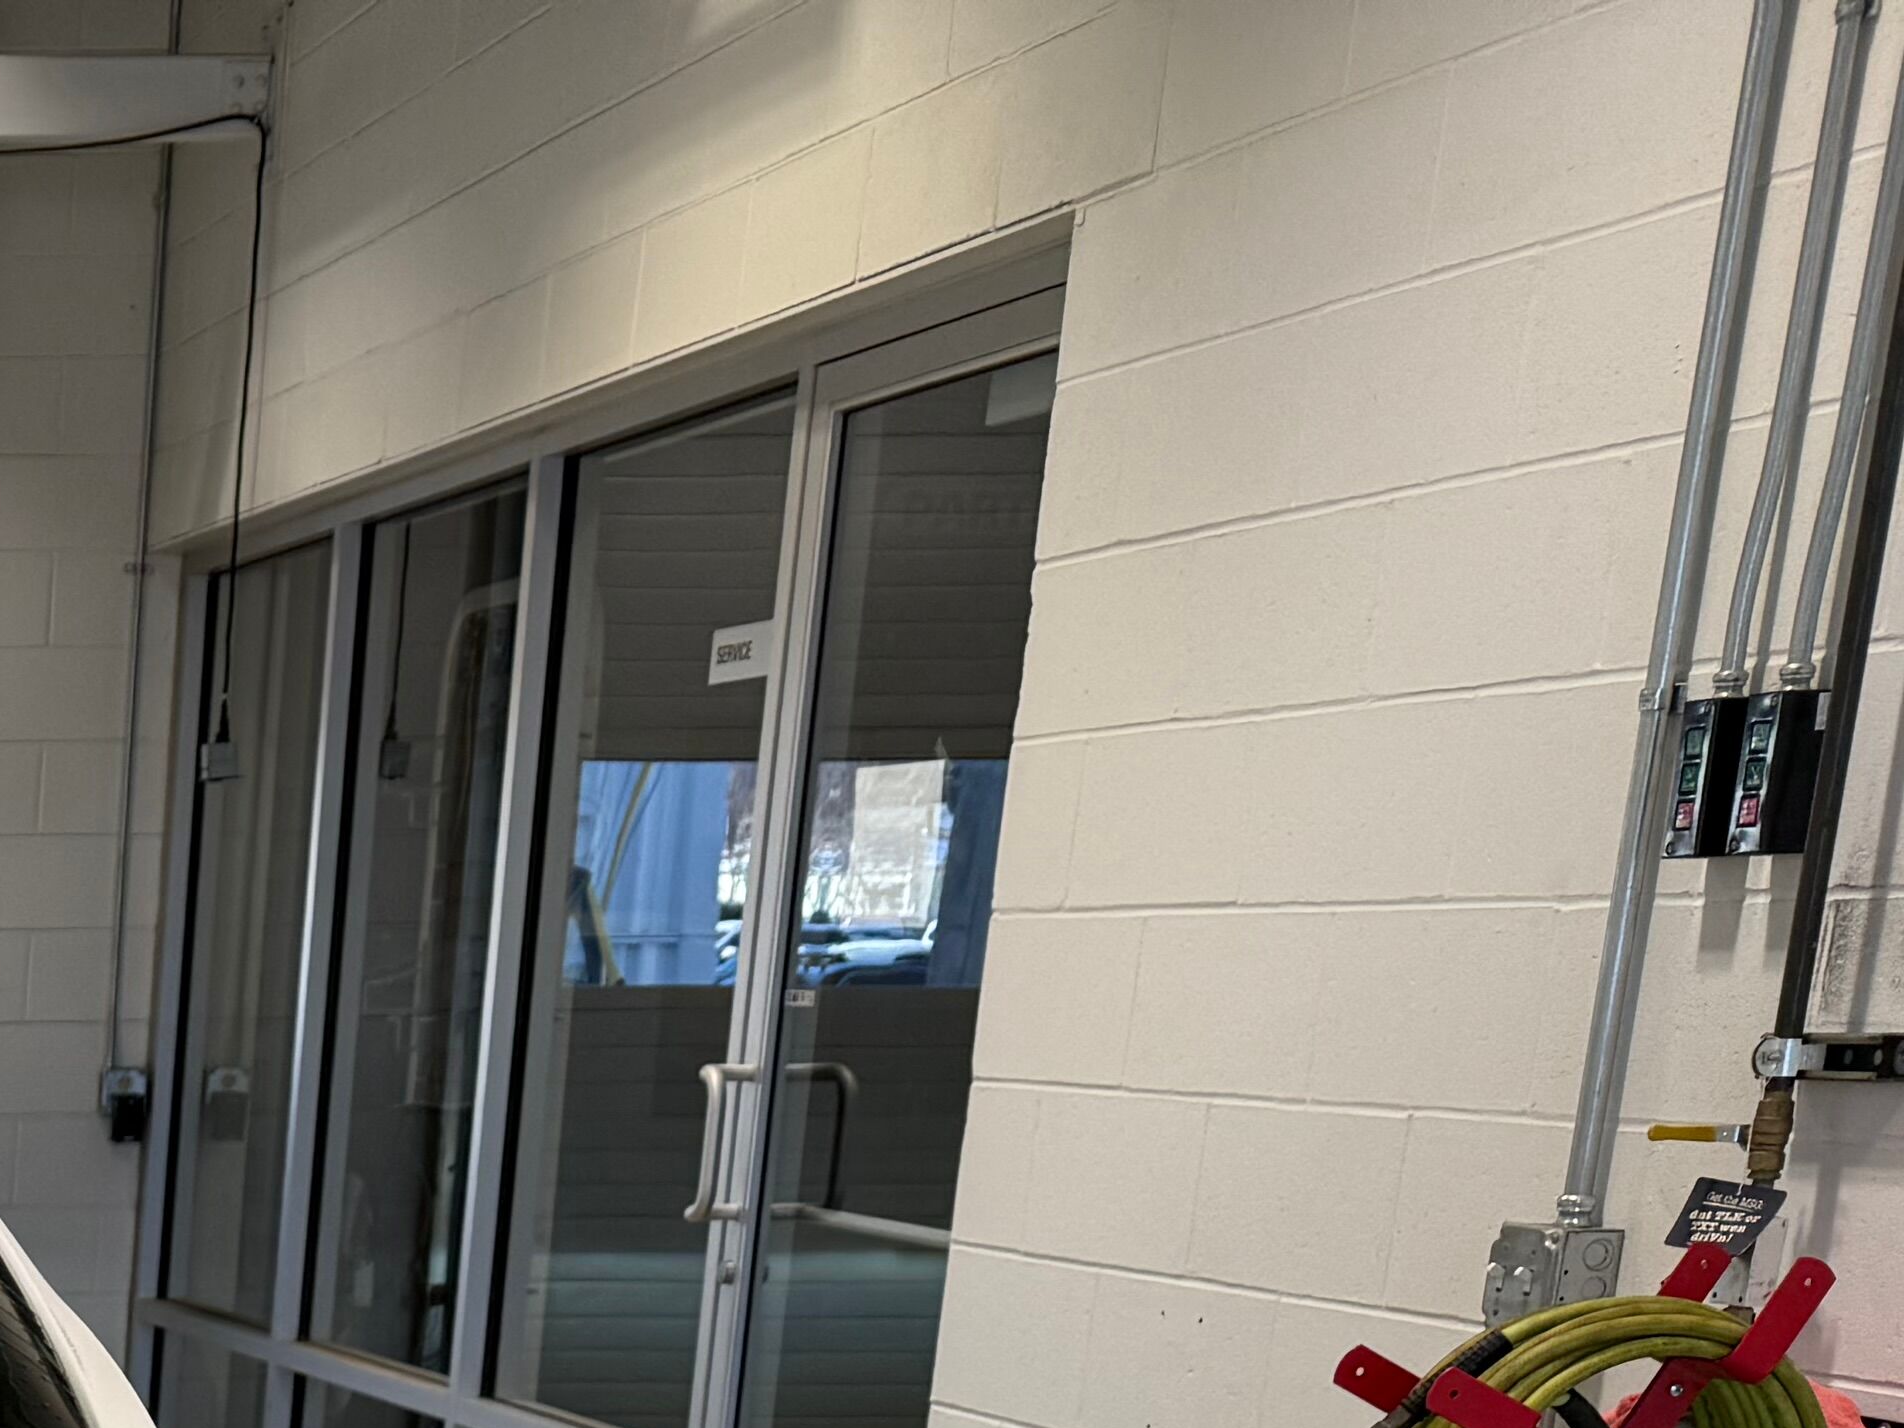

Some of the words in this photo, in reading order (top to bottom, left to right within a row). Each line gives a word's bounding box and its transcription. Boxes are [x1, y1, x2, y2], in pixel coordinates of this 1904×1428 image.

[716, 640, 753, 664] SERVICE
[1706, 1191, 1723, 1203] Get
[1714, 1211, 1746, 1222] TLK
[1745, 1215, 1762, 1223] or
[1690, 1221, 1719, 1231] TXT
[1719, 1224, 1747, 1233] wen
